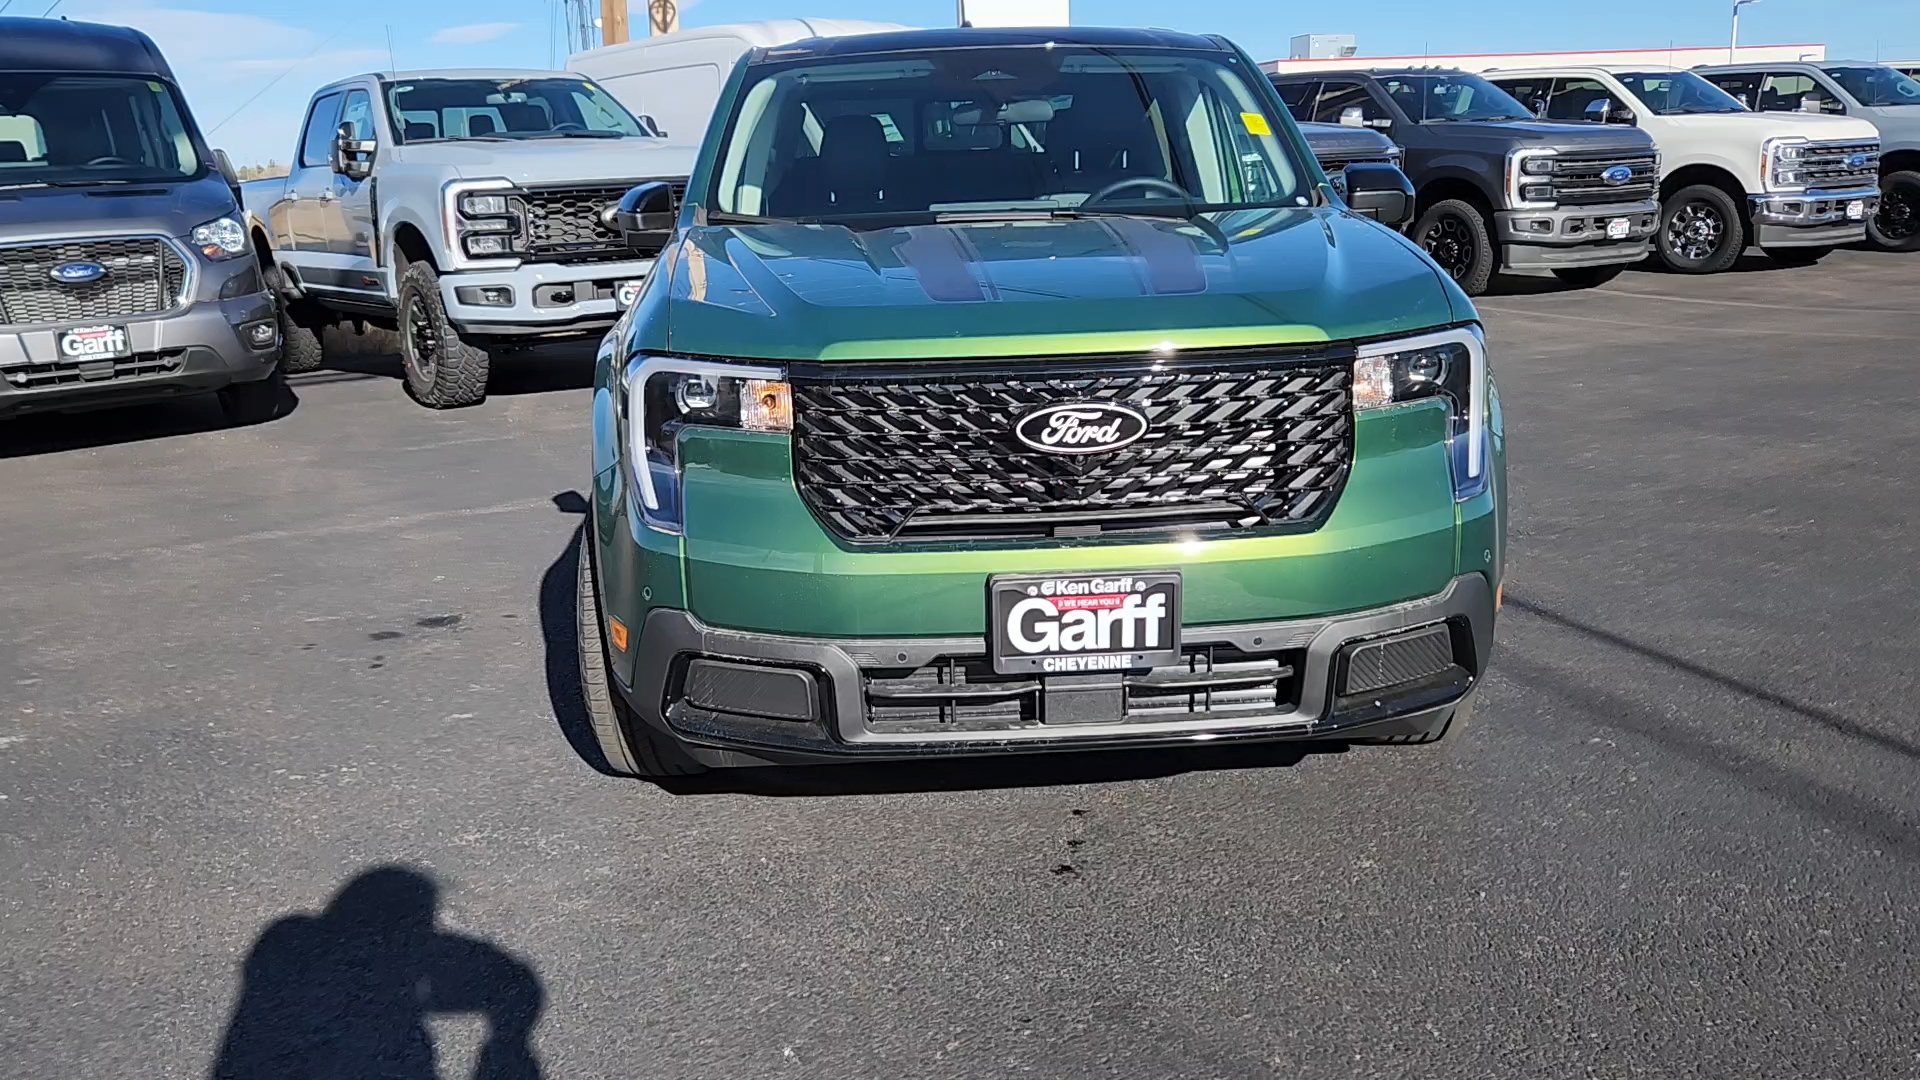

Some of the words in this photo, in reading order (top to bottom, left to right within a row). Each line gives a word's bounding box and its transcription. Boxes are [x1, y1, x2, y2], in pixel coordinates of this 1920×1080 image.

[61, 329, 124, 356] Garff
[1041, 411, 1122, 444] Ford
[1056, 580, 1090, 596] Ken
[1090, 578, 1133, 594] Garff
[1064, 599, 1077, 608] WE
[1078, 598, 1099, 607] HEAR
[1099, 597, 1115, 606] YOU
[1007, 593, 1166, 653] Garff
[1043, 655, 1133, 671] CHEYENNE
